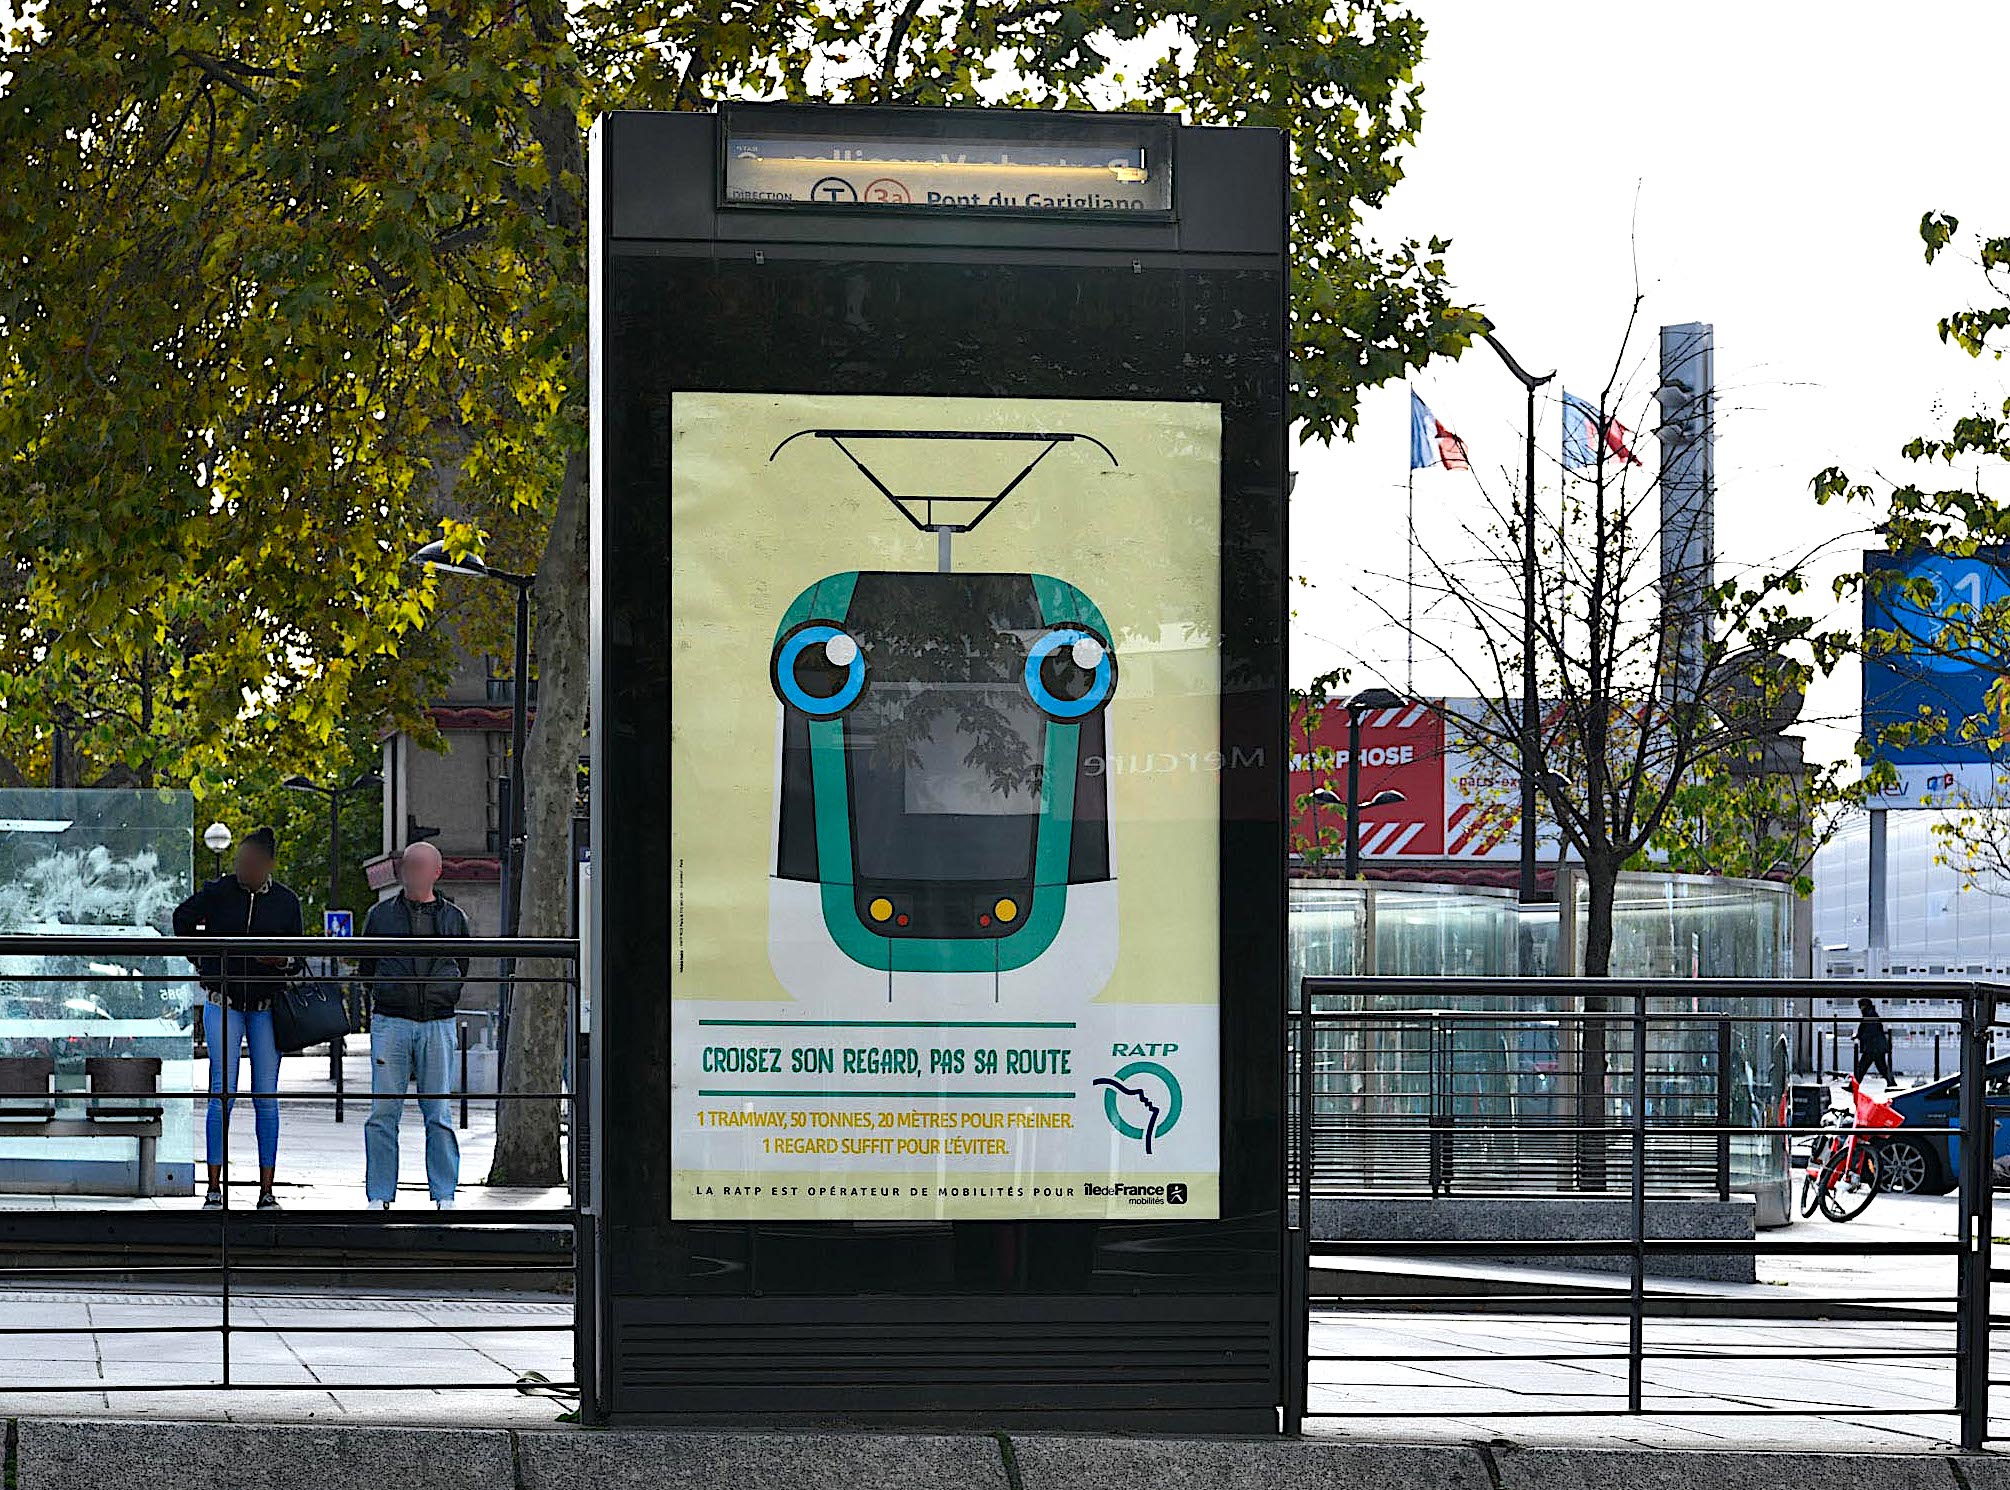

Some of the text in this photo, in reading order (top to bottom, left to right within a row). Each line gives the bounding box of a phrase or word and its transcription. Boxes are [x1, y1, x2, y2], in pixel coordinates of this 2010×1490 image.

[732, 190, 792, 201] DIRECTION
[927, 191, 980, 207] Pont
[989, 192, 1016, 207] du
[1025, 193, 1144, 209] Garigliano
[1289, 745, 1414, 772] MOPHOSE
[1112, 1043, 1179, 1057] RATP
[702, 1046, 1072, 1078] CROISEZ SON REGARD, PAS SA ROUTE
[696, 1109, 1075, 1131] 1 TRAMWAY, 50 TONNES, 20 MÈTRES POUR FREINER.
[763, 1135, 1009, 1155] 1 REGARD SUFFIT POUR L'ÉVITER.
[696, 1185, 1075, 1197] LA RATP EST OPÉRATEUR DE MOBILITÉS POUR
[1128, 1197, 1165, 1205] mobilités
